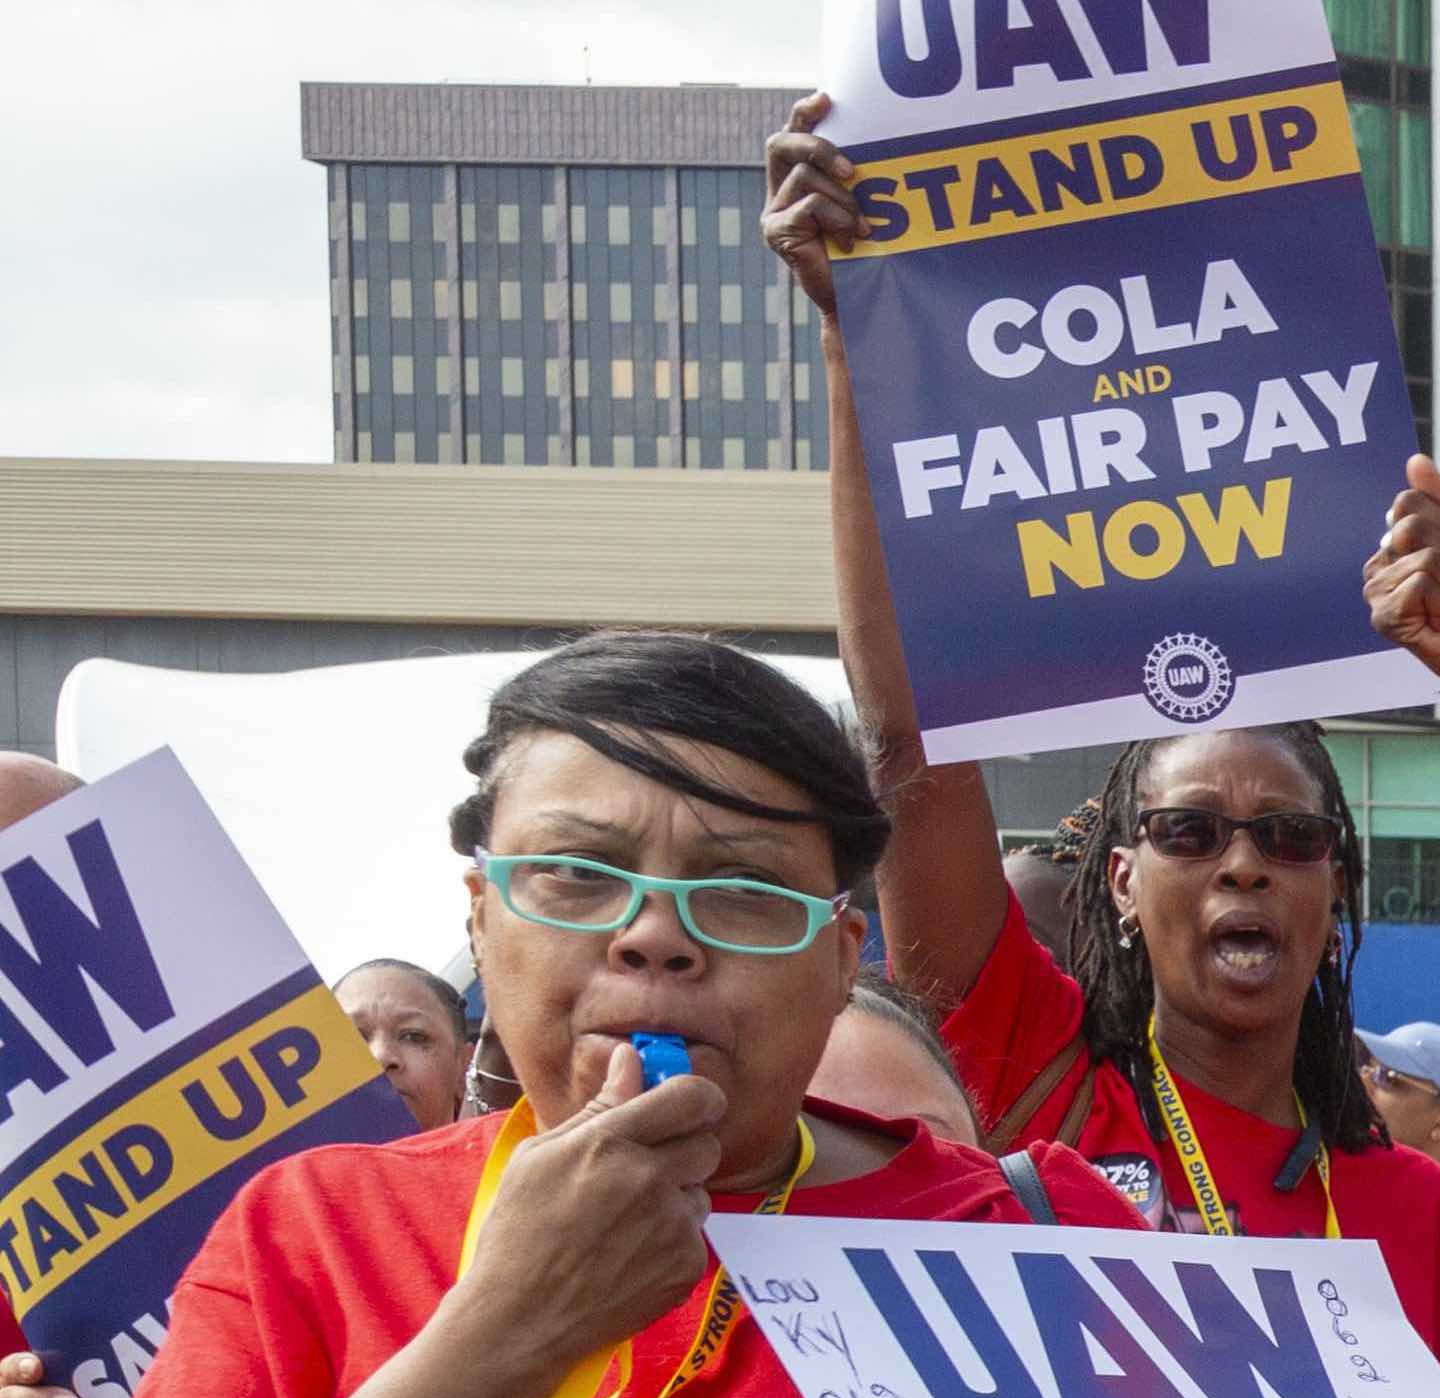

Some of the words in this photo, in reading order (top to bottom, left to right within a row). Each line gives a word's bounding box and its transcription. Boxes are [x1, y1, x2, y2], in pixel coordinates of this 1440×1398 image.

[878, 0, 1210, 98] UAW
[852, 137, 1161, 240] STAND
[1193, 108, 1315, 179] UP
[967, 260, 1278, 378] COLA
[893, 409, 1156, 518] FAIR
[1173, 362, 1378, 472] PAY
[1093, 364, 1172, 402] AND
[1018, 480, 1289, 595] NOW
[0, 1122, 175, 1293] TAND
[180, 1023, 323, 1144] UP
[691, 1278, 740, 1372] STRON
[739, 1273, 820, 1305] LOU
